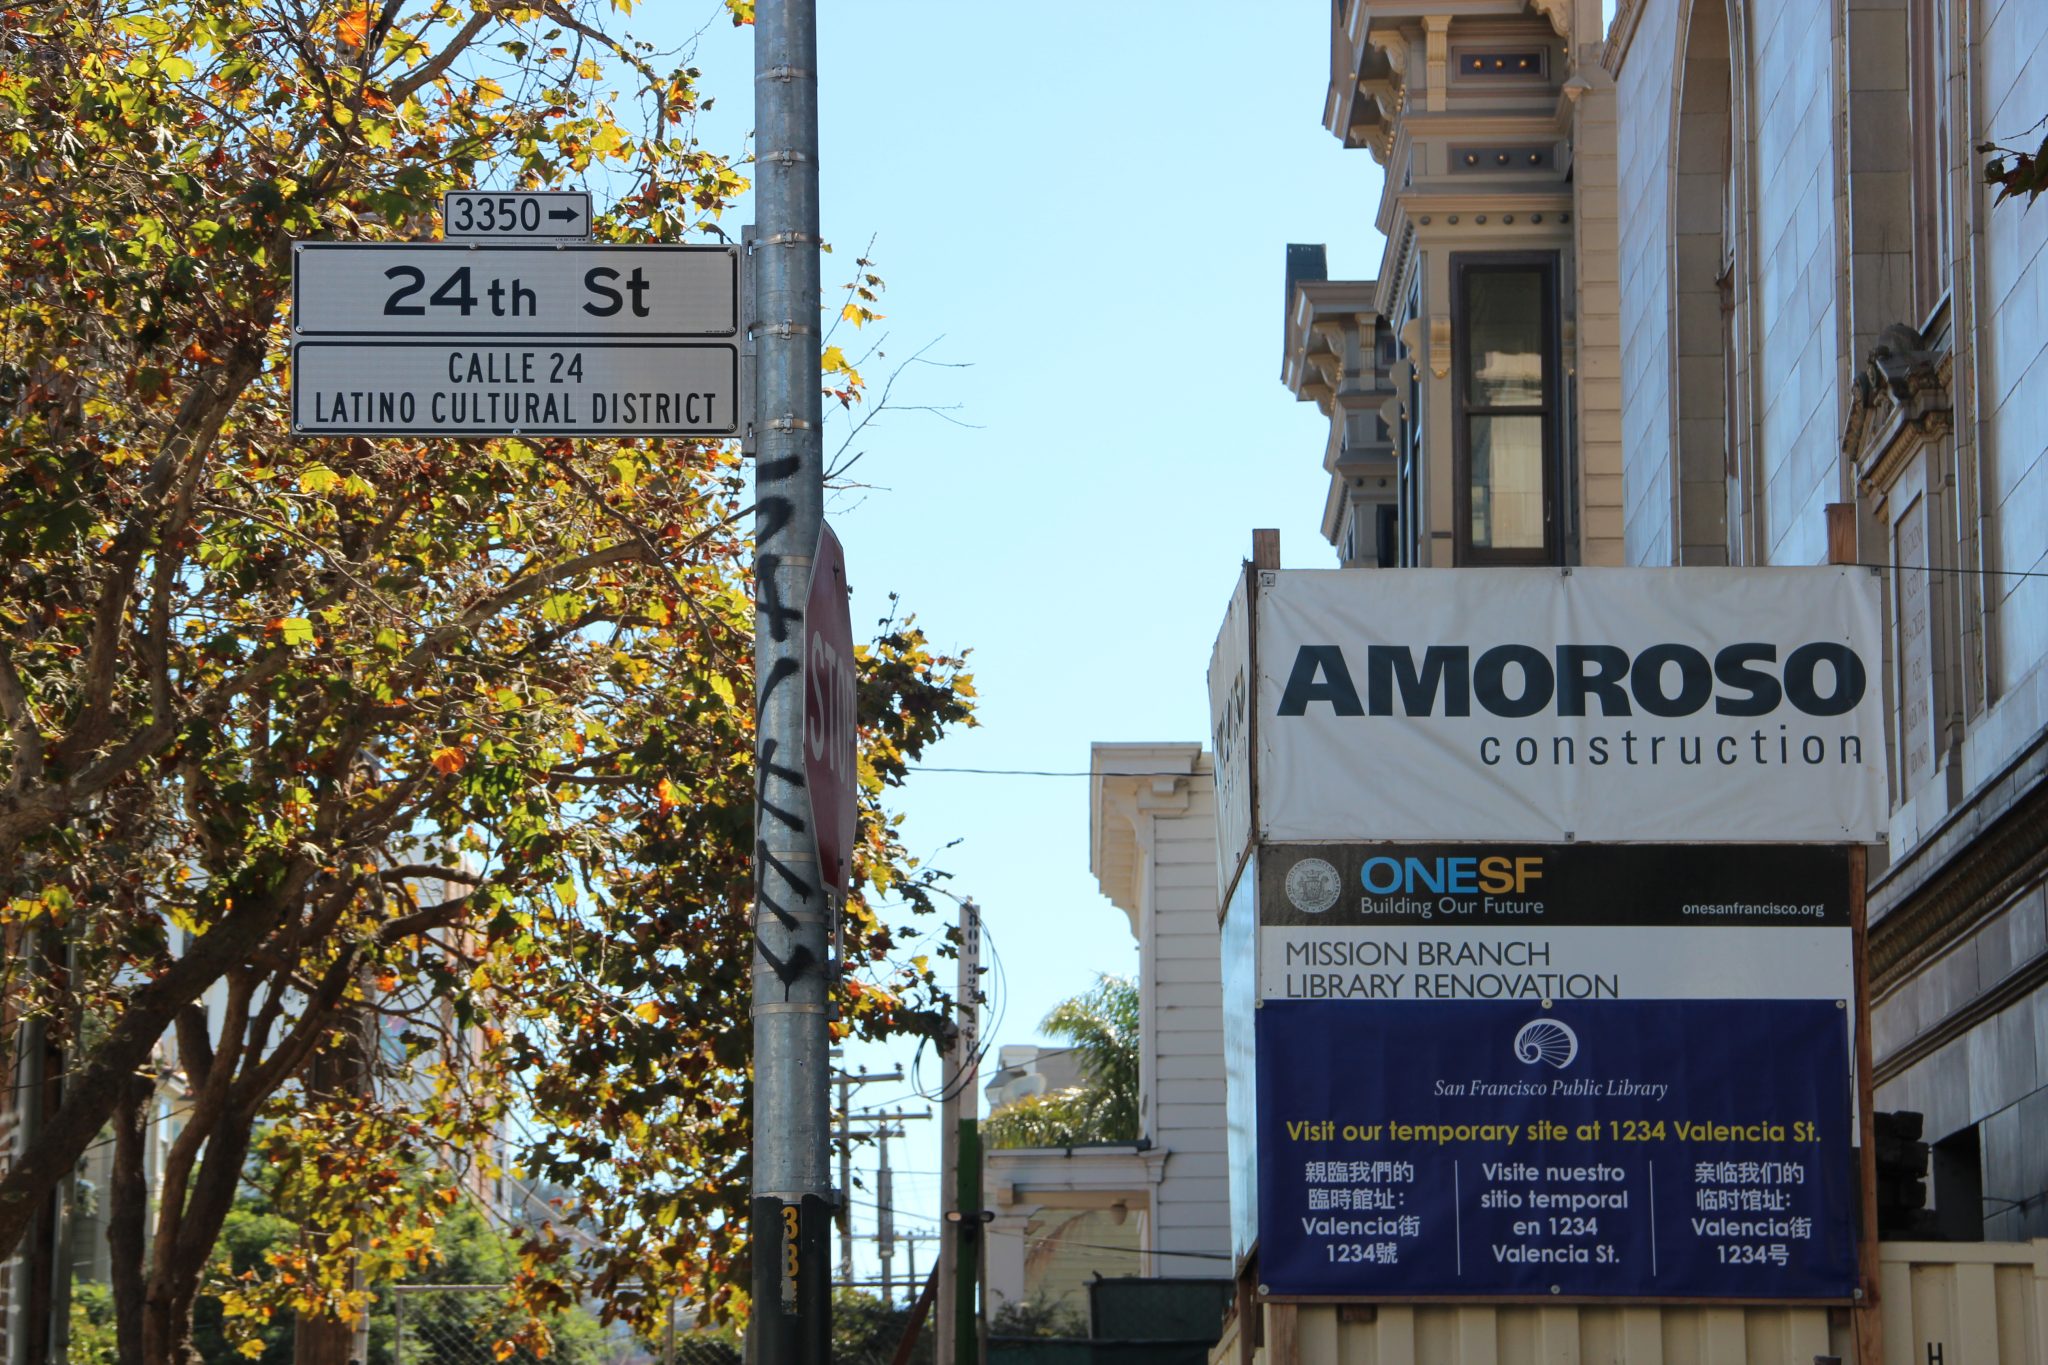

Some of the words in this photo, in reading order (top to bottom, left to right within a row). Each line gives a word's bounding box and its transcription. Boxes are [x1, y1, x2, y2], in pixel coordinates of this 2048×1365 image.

[454, 197, 541, 232] 3350
[383, 265, 537, 317] 24th
[582, 266, 650, 318] St
[448, 351, 535, 384] CALLE
[549, 352, 584, 384] 24
[315, 391, 415, 424] LATINO
[431, 391, 577, 424] CULTURAL
[592, 392, 716, 425] DISTRICT
[1276, 641, 1867, 719] AMOROSO
[809, 630, 856, 791] STOP
[1480, 724, 1863, 766] construction
[1360, 855, 1544, 895] ONESF
[1360, 896, 1433, 918] Building
[1438, 896, 1478, 914] Our
[1484, 896, 1544, 914] Future
[1682, 901, 1825, 918] onesanfrancisco.org
[1286, 941, 1408, 966] MISSION
[1418, 941, 1550, 967] BRANCH
[1286, 973, 1405, 999] LIBRARY
[1414, 973, 1618, 999] RENOVATION
[1434, 1079, 1465, 1096] San
[1469, 1079, 1548, 1096] Francisco
[1551, 1078, 1603, 1096] Public
[1606, 1078, 1668, 1102] Library
[1286, 1120, 1336, 1141] Visit
[1342, 1125, 1383, 1141] our
[1388, 1120, 1520, 1146] temporary
[1527, 1119, 1569, 1141] site
[1575, 1120, 1601, 1141] at
[1609, 1120, 1666, 1141] 1234
[1673, 1120, 1785, 1142] Valencia
[1793, 1121, 1822, 1142] St.
[1305, 1160, 1414, 1183] 親臨我們的
[1482, 1162, 1540, 1182] Visite
[1546, 1163, 1625, 1182] nuestro
[1694, 1161, 1804, 1185] 亲临我们的
[1481, 1189, 1523, 1209] sitio
[1528, 1189, 1628, 1213] temporal
[1513, 1221, 1541, 1236] en
[1548, 1217, 1598, 1236] 1234
[1492, 1243, 1589, 1264] Valencia
[1596, 1244, 1620, 1263] St.
